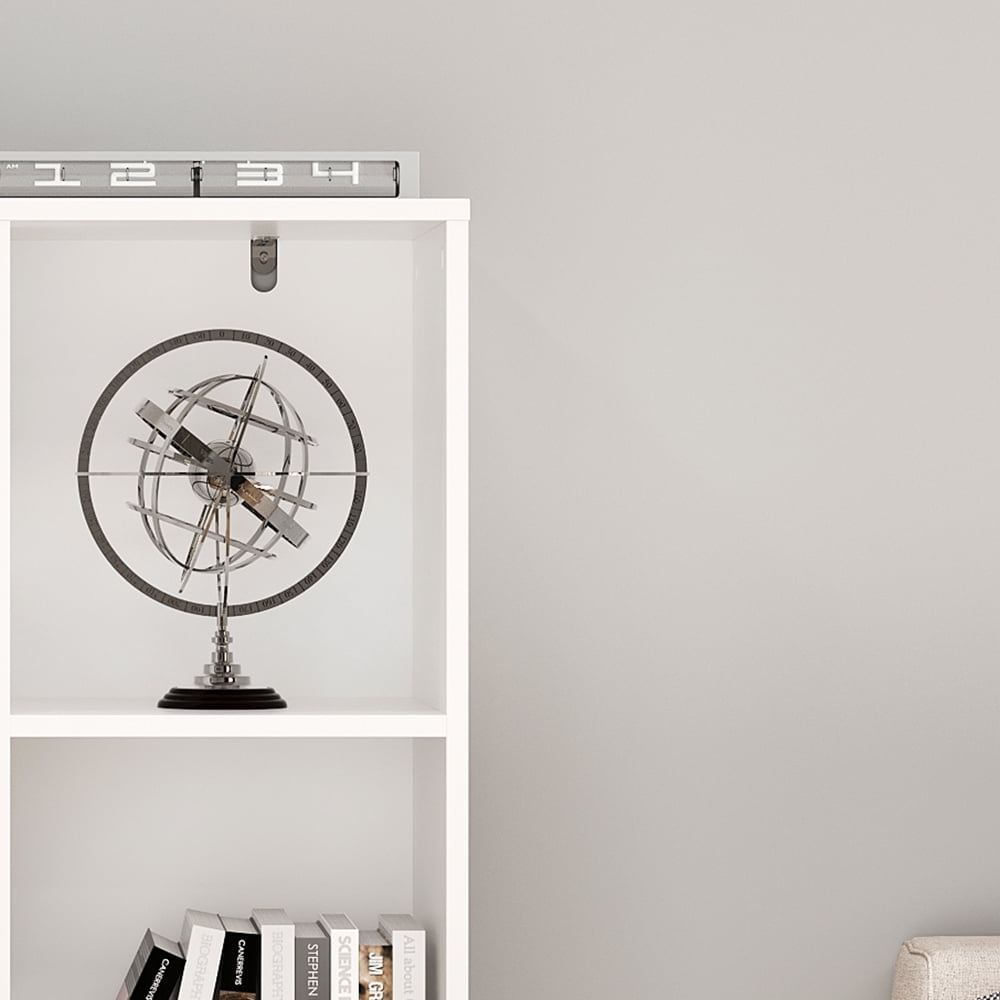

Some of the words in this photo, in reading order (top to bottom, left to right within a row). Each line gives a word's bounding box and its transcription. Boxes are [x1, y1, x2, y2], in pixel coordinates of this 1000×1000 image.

[235, 940, 246, 986] CANERREVIS
[338, 935, 351, 994] SCIENCE
[369, 952, 384, 975] JIM
[404, 935, 415, 954] All
[307, 943, 319, 997] STEPHEN
[404, 955, 415, 994] about
